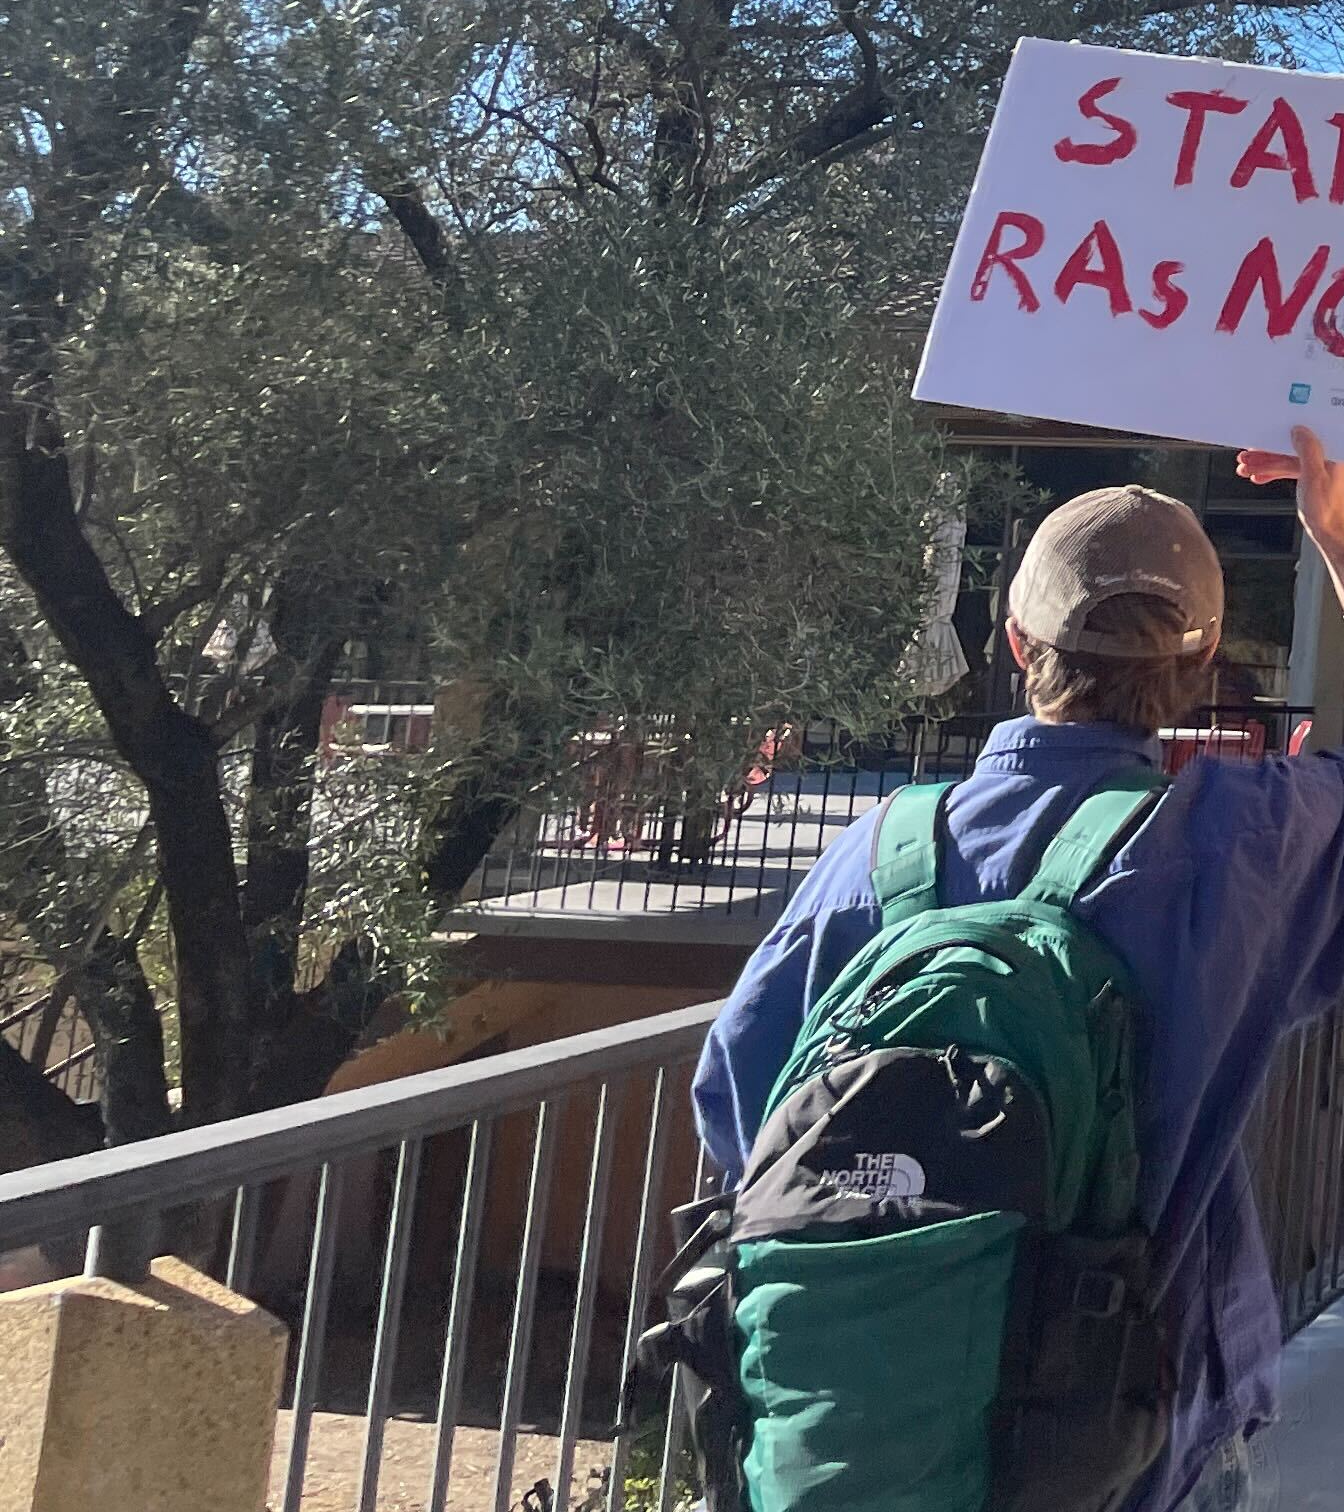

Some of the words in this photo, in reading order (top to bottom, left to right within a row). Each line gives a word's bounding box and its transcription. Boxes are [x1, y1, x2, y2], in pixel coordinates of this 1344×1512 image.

[970, 210, 1190, 330] RAs
[855, 1152, 895, 1170] THE
[819, 1169, 892, 1186] NORTH
